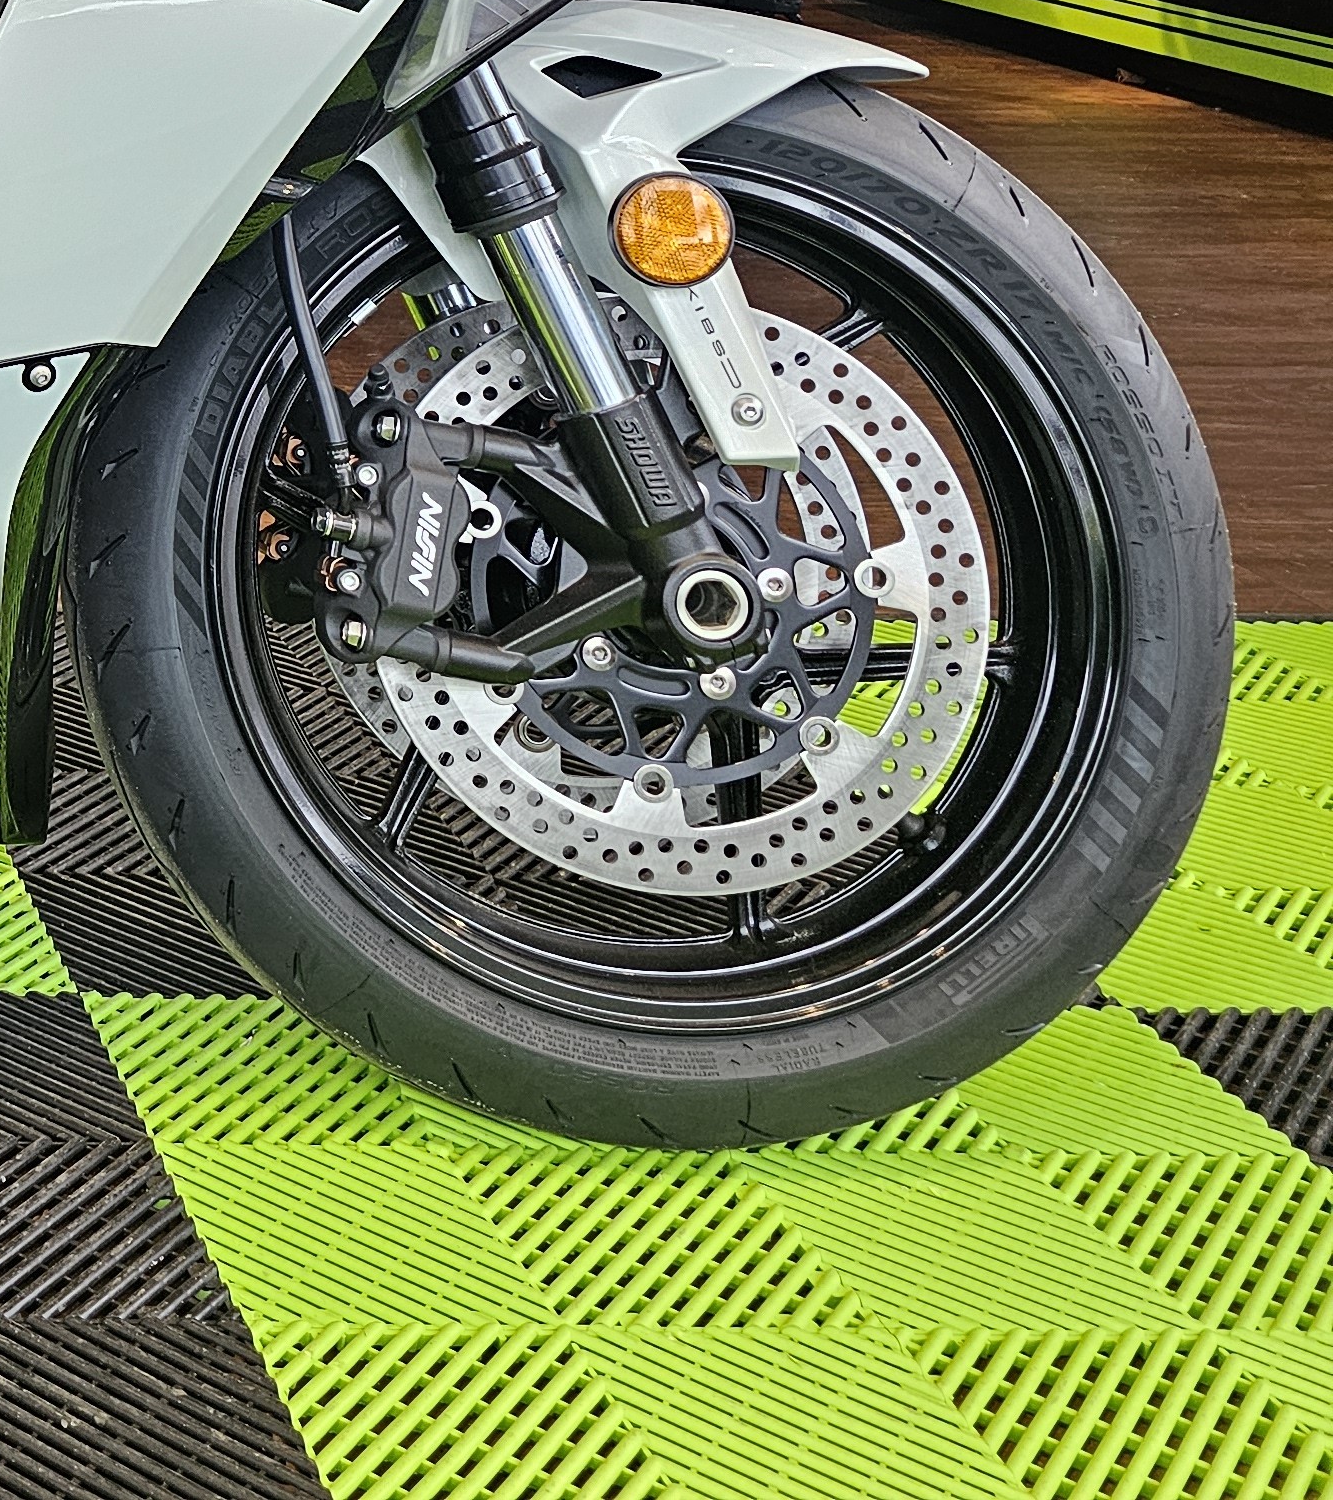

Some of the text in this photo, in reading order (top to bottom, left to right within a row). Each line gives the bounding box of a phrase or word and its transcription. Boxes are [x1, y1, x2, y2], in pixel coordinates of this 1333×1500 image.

[615, 415, 678, 508] SHOWA
[409, 491, 443, 597] NISSIN
[937, 908, 1052, 1013] PIRELLI
